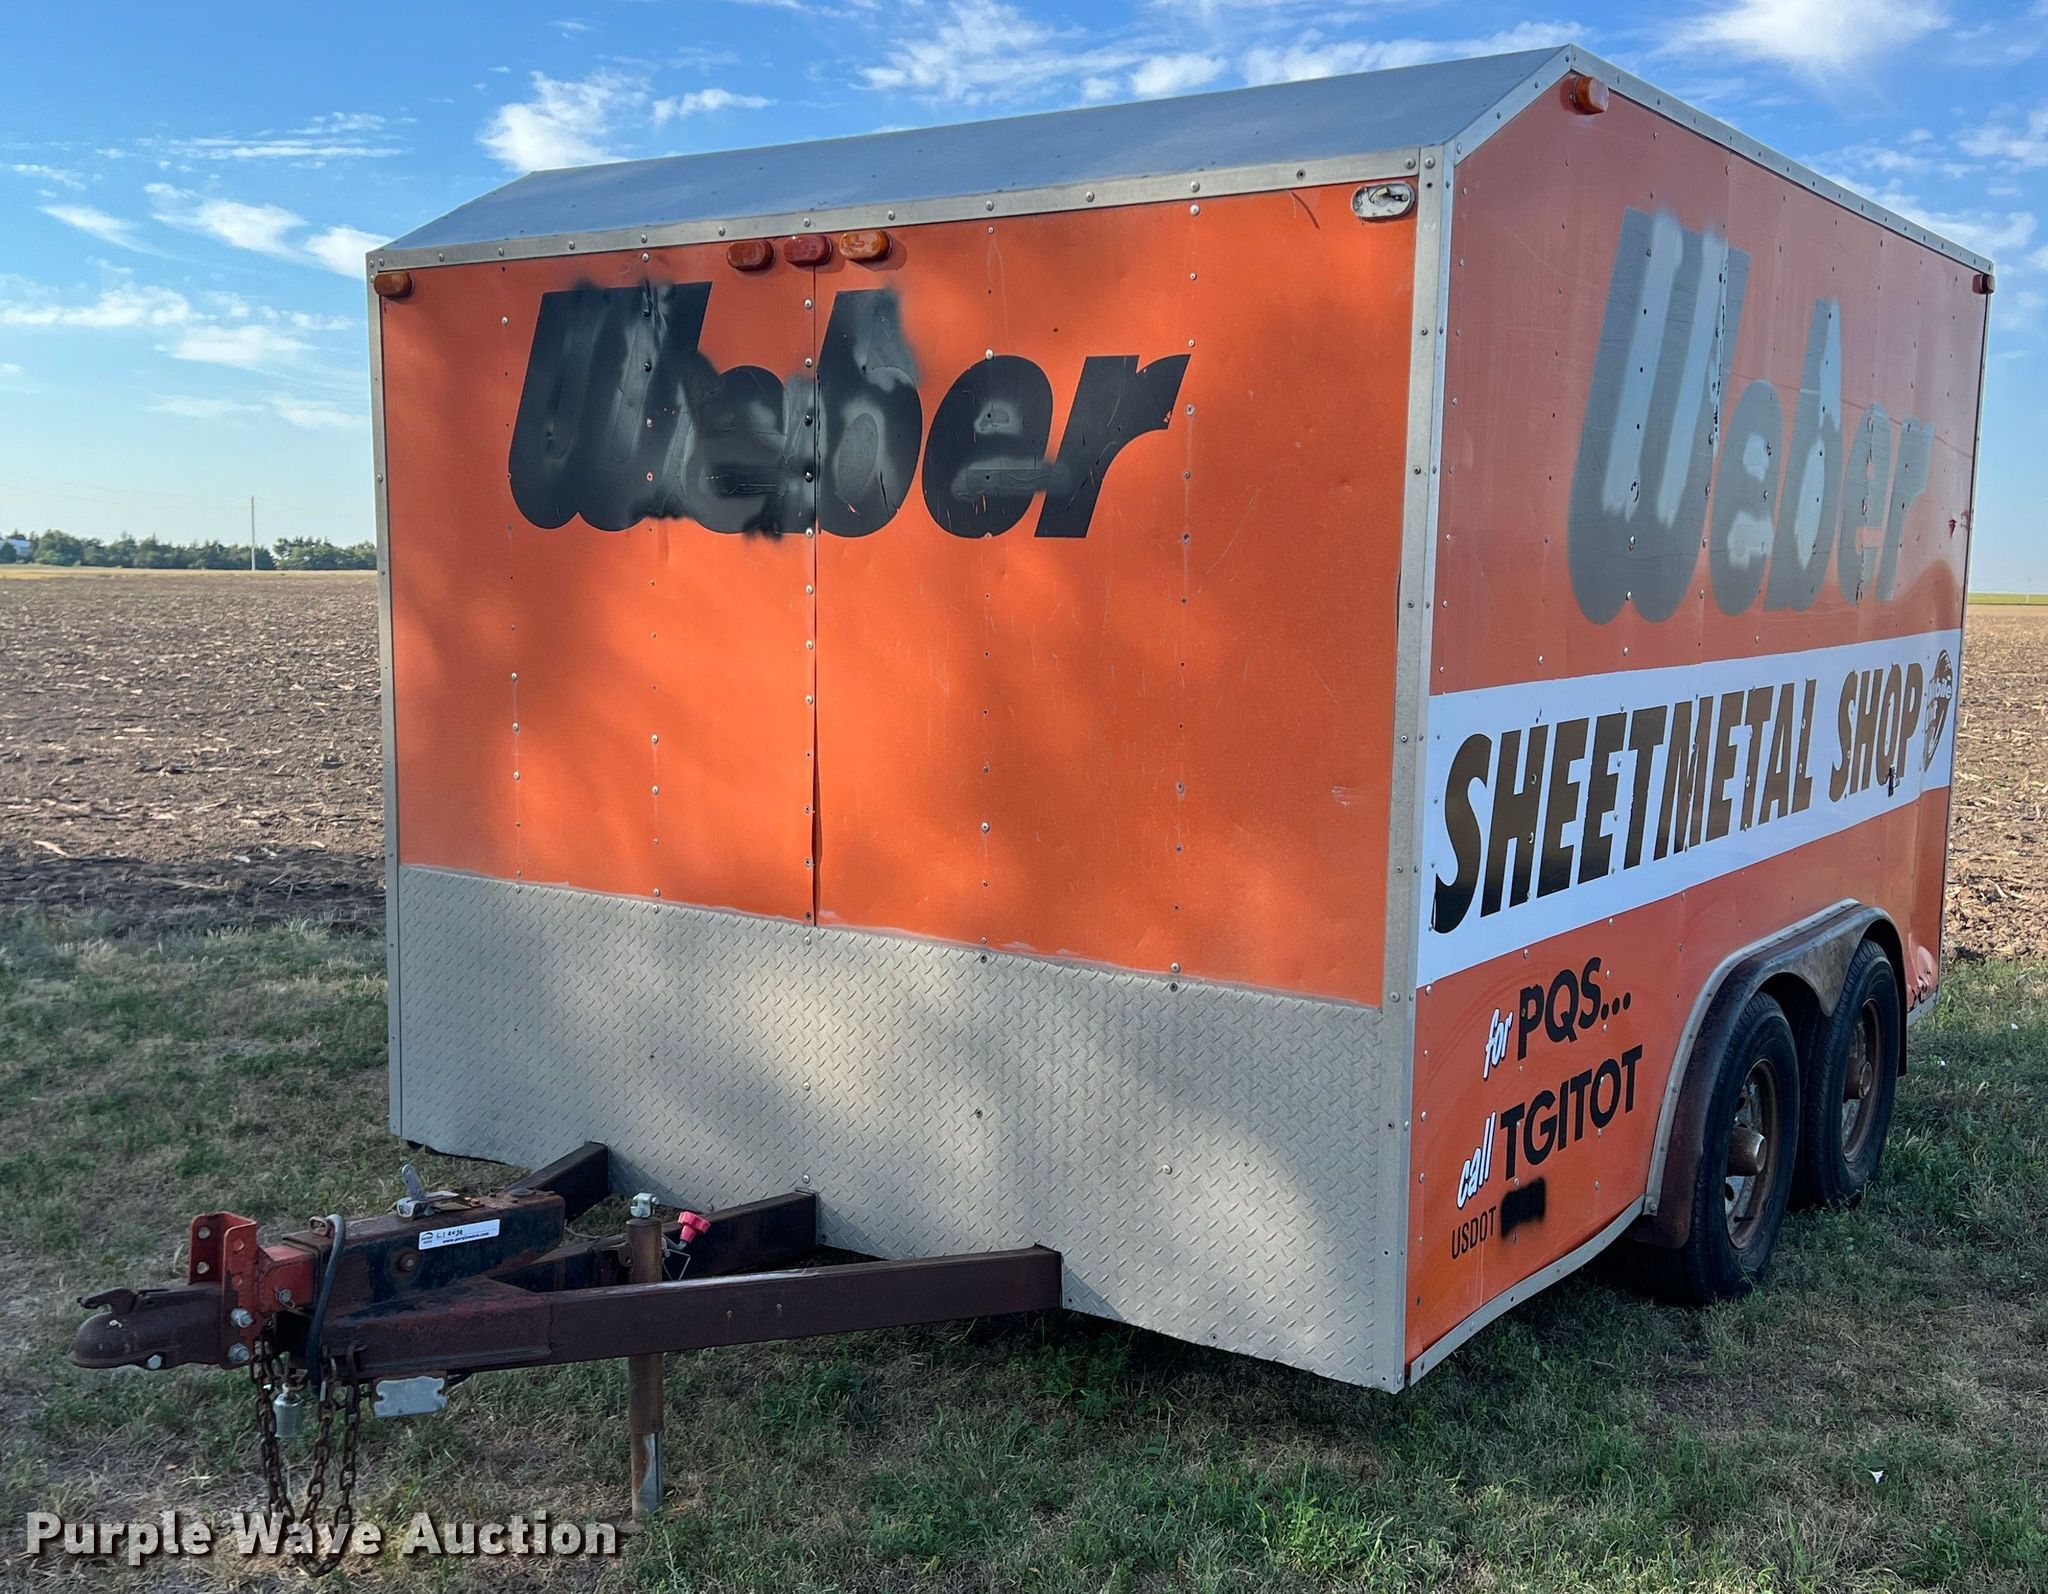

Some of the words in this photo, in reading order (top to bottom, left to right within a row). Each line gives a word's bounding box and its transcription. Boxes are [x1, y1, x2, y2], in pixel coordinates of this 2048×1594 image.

[1432, 679, 1817, 934] SHEETMETAL
[1829, 662, 1924, 803] SHOP
[1482, 1008, 1513, 1080] for
[1517, 957, 1632, 1061] PQS...
[1457, 1111, 1496, 1209] call
[1500, 1044, 1643, 1181] TGITOT
[1451, 1206, 1496, 1260] USDOT
